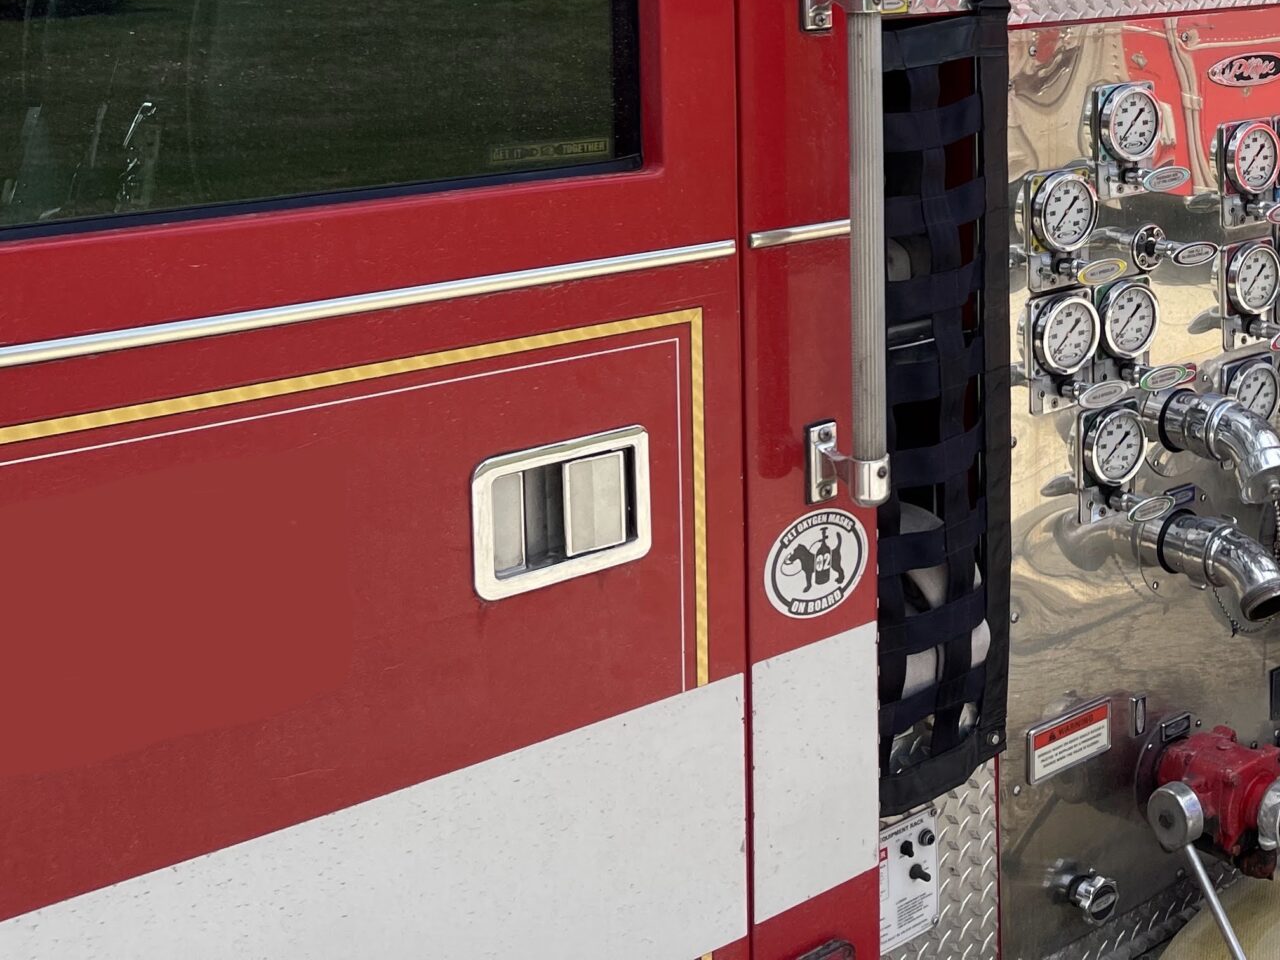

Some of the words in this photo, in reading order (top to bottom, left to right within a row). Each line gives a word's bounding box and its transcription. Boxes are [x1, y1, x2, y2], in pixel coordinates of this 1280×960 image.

[562, 141, 605, 154] TOGETHER
[782, 527, 797, 545] PET
[797, 514, 828, 531] OXYGEN
[828, 513, 854, 530] MASKS
[791, 600, 806, 614] ON
[807, 589, 842, 613] BOARD
[880, 824, 909, 842] QUIPMENT
